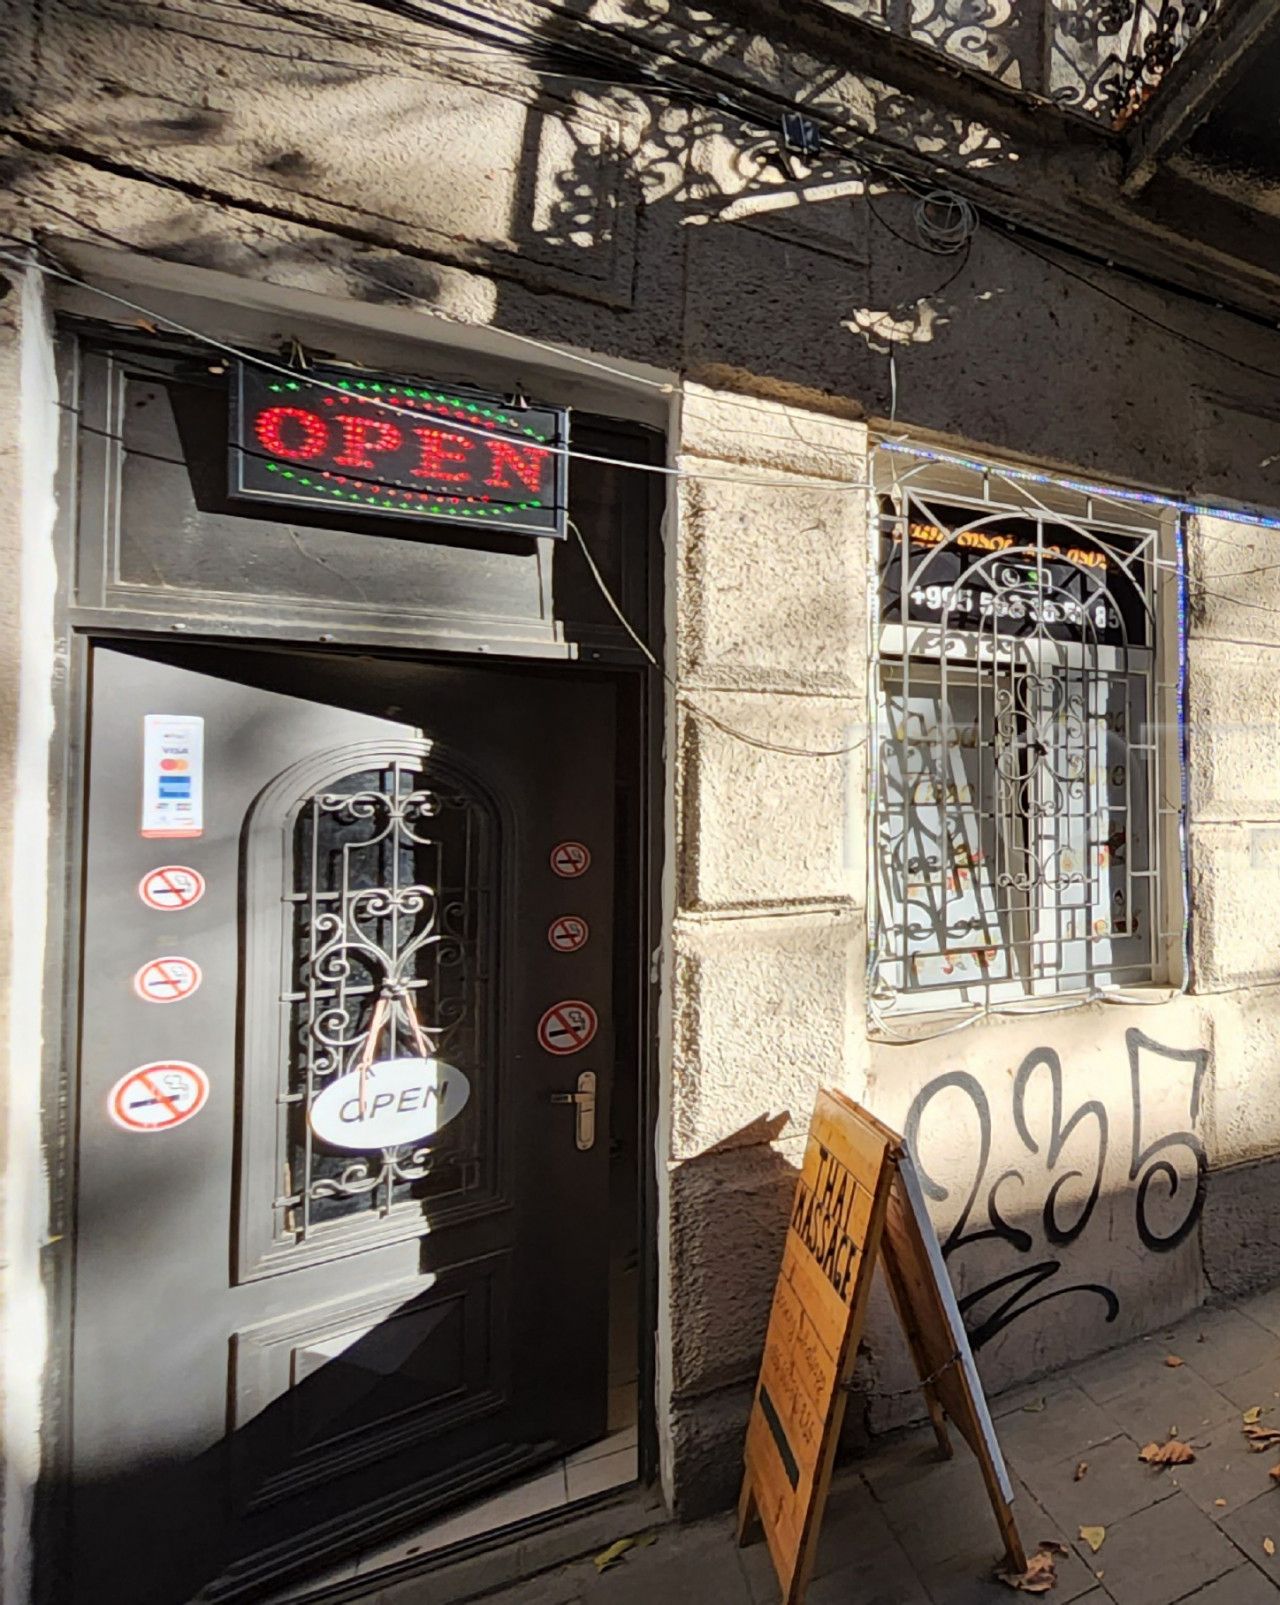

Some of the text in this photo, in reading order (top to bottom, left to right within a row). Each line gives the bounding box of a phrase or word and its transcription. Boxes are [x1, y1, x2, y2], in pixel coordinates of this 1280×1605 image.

[254, 406, 550, 493] OPEN
[339, 1080, 449, 1123] OPEN
[812, 1143, 858, 1234] THAI
[791, 1186, 858, 1303] MASSAGE
